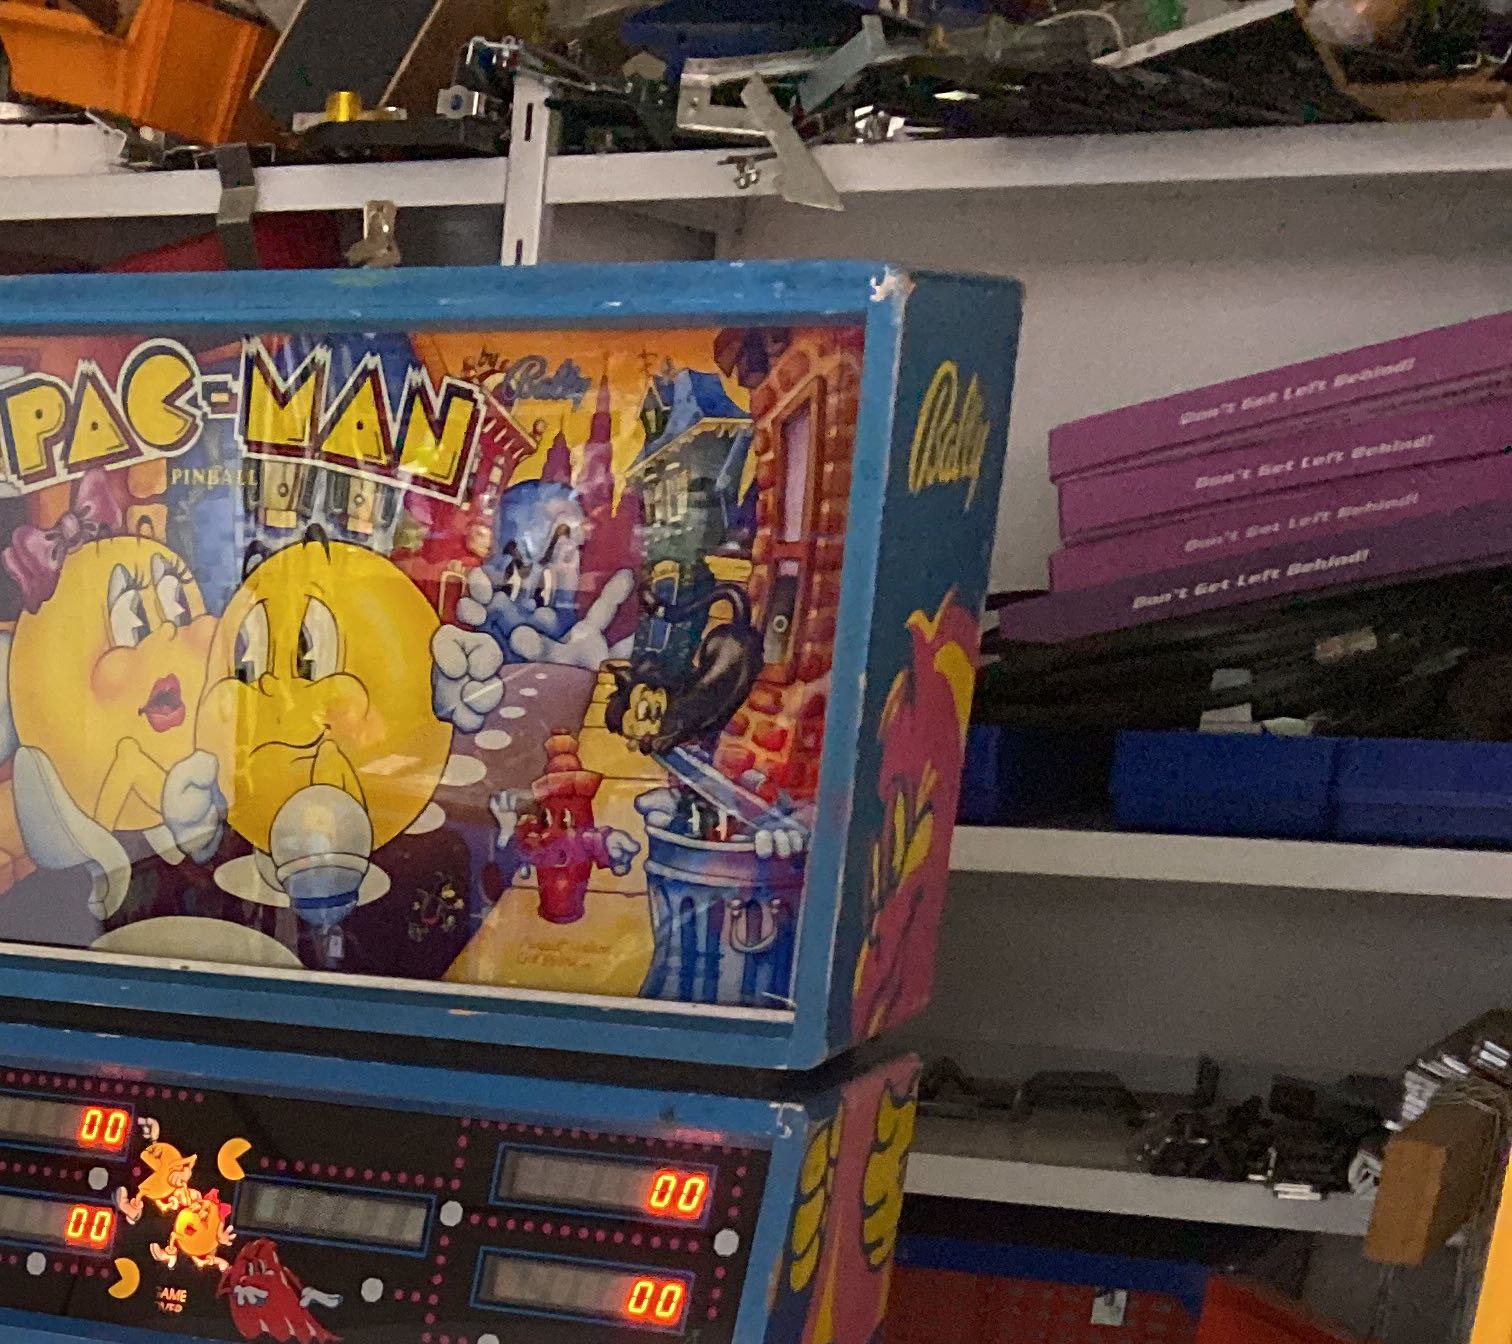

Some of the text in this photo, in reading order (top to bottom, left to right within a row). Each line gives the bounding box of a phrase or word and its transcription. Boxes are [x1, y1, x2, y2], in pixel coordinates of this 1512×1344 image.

[1180, 357, 1416, 425] Don't Get Left Behind!
[171, 466, 258, 487] PINBALL
[1195, 434, 1435, 489] Don't Get Left Behind!
[1338, 492, 1419, 519] Behind!
[1132, 549, 1370, 609] Don't Get Left Behind!
[81, 1108, 127, 1144] 00
[649, 1174, 705, 1211] 00
[66, 1206, 112, 1242] 00
[627, 1280, 683, 1318] 00
